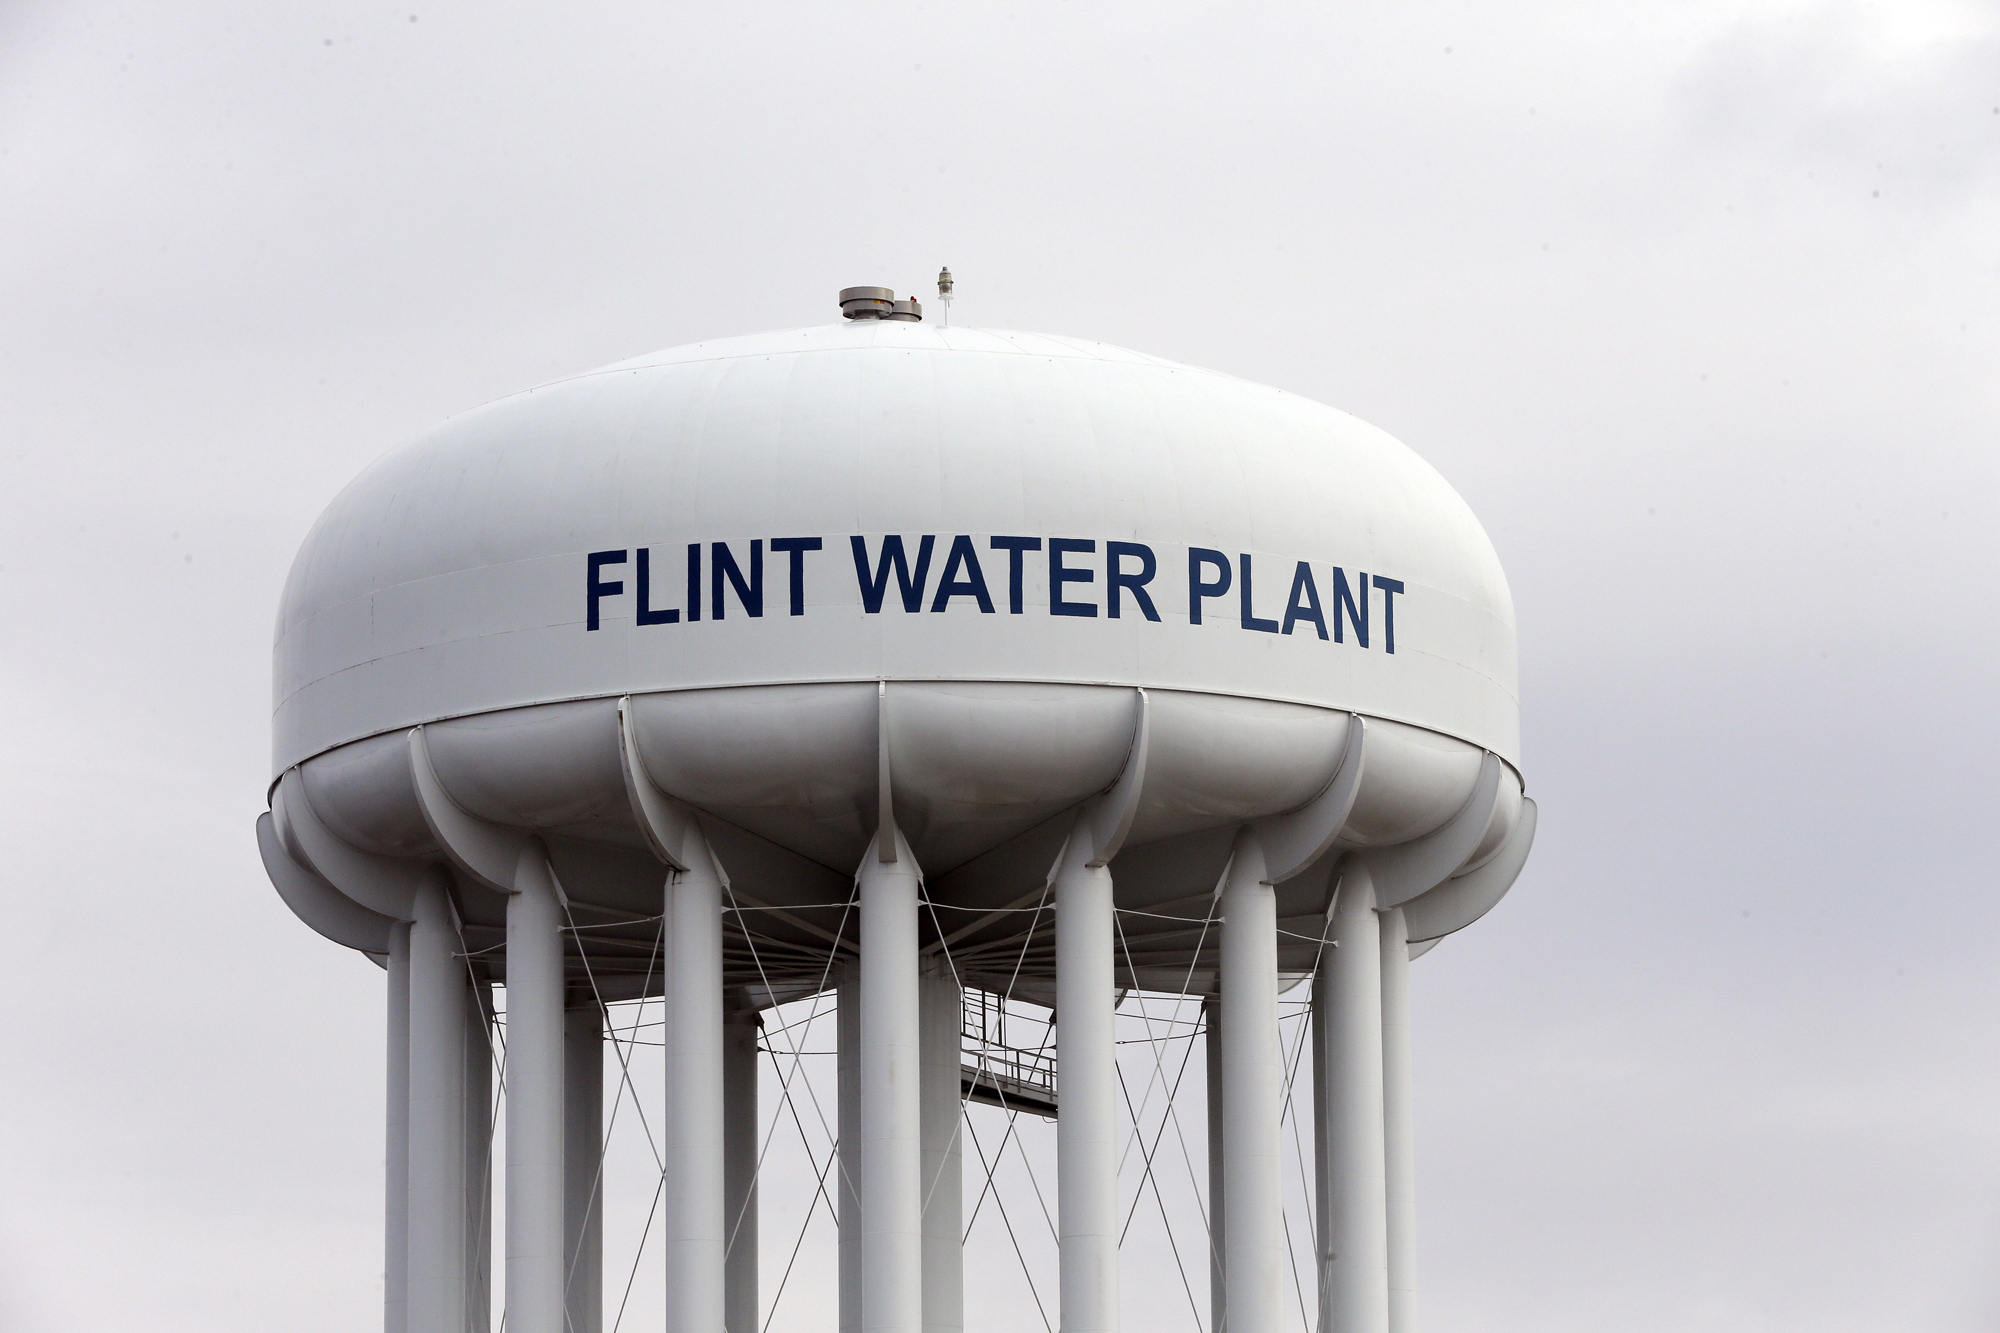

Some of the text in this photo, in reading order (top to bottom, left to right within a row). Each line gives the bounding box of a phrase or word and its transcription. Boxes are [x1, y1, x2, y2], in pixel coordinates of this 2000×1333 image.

[586, 534, 1405, 655] FLINT WATER PLANT
